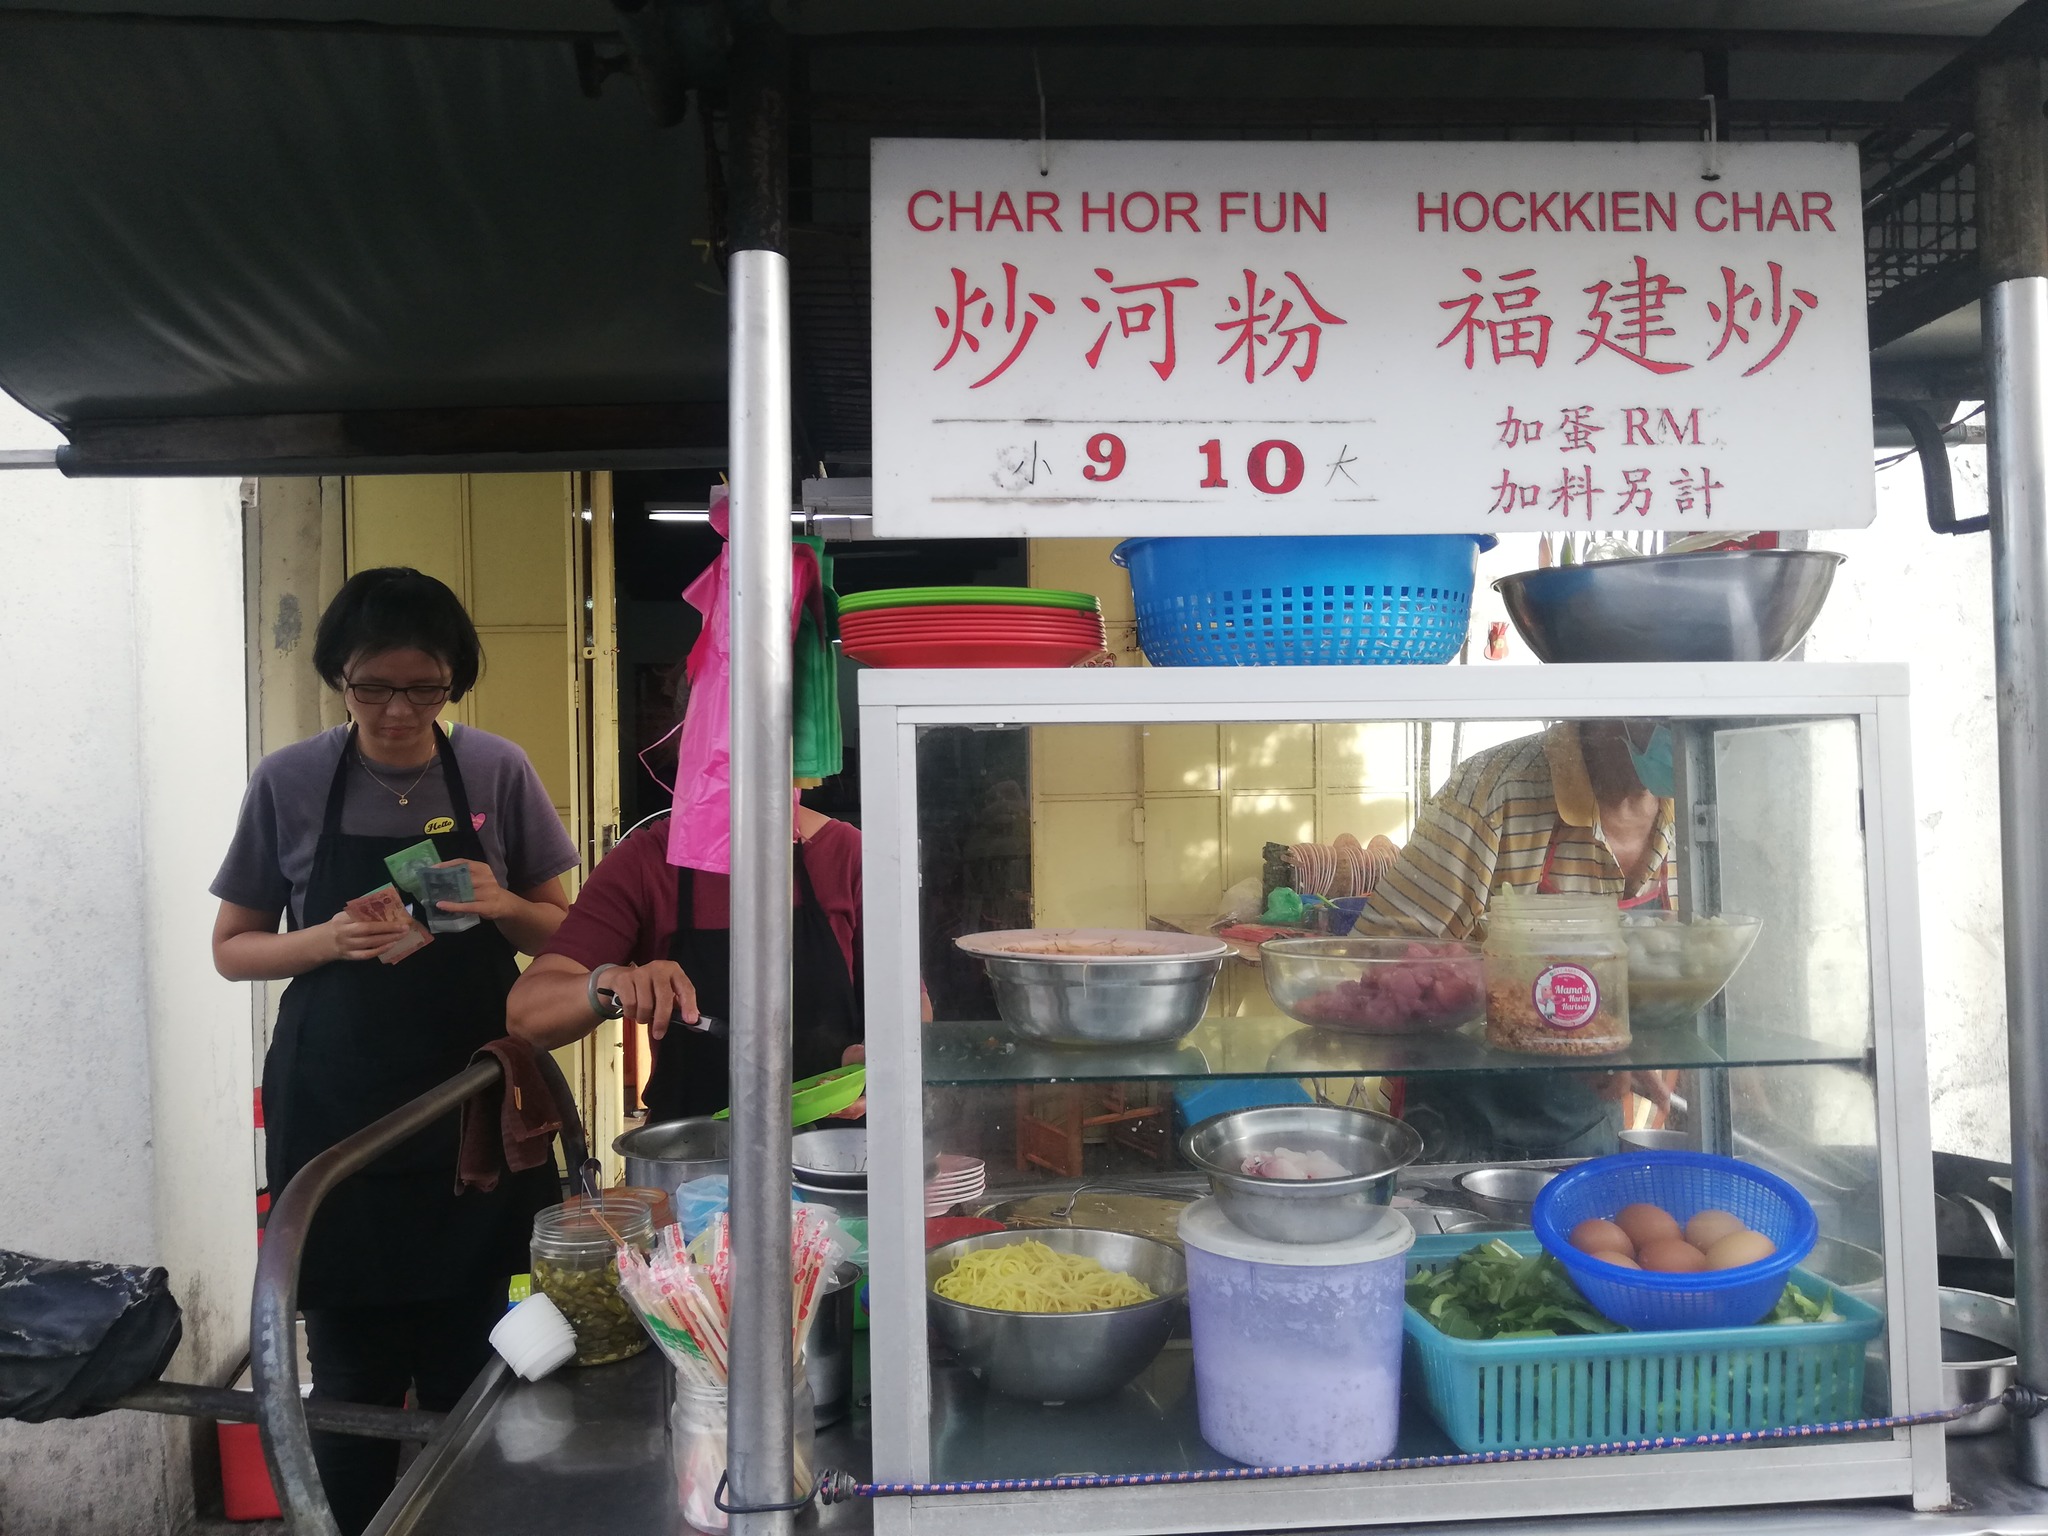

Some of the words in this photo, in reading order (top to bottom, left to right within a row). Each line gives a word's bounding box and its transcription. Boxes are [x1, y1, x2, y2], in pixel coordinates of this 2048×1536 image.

[907, 189, 1063, 232] CHAR
[1081, 191, 1201, 233] HOR
[1220, 191, 1327, 233] FUN
[1416, 191, 1677, 232] HOCKKIEN
[1694, 191, 1837, 232] CHAR
[932, 262, 1348, 389] 炒河粉
[1436, 255, 1820, 378] 福建炒
[1495, 405, 1606, 455] 加蛋
[1620, 406, 1706, 446] RM
[1012, 440, 1053, 485] 小
[1082, 432, 1127, 482] 9
[1198, 439, 1306, 494] 10
[1487, 464, 1726, 522] 加料另計
[426, 820, 452, 833] Hello
[1554, 984, 1590, 995] Mama's
